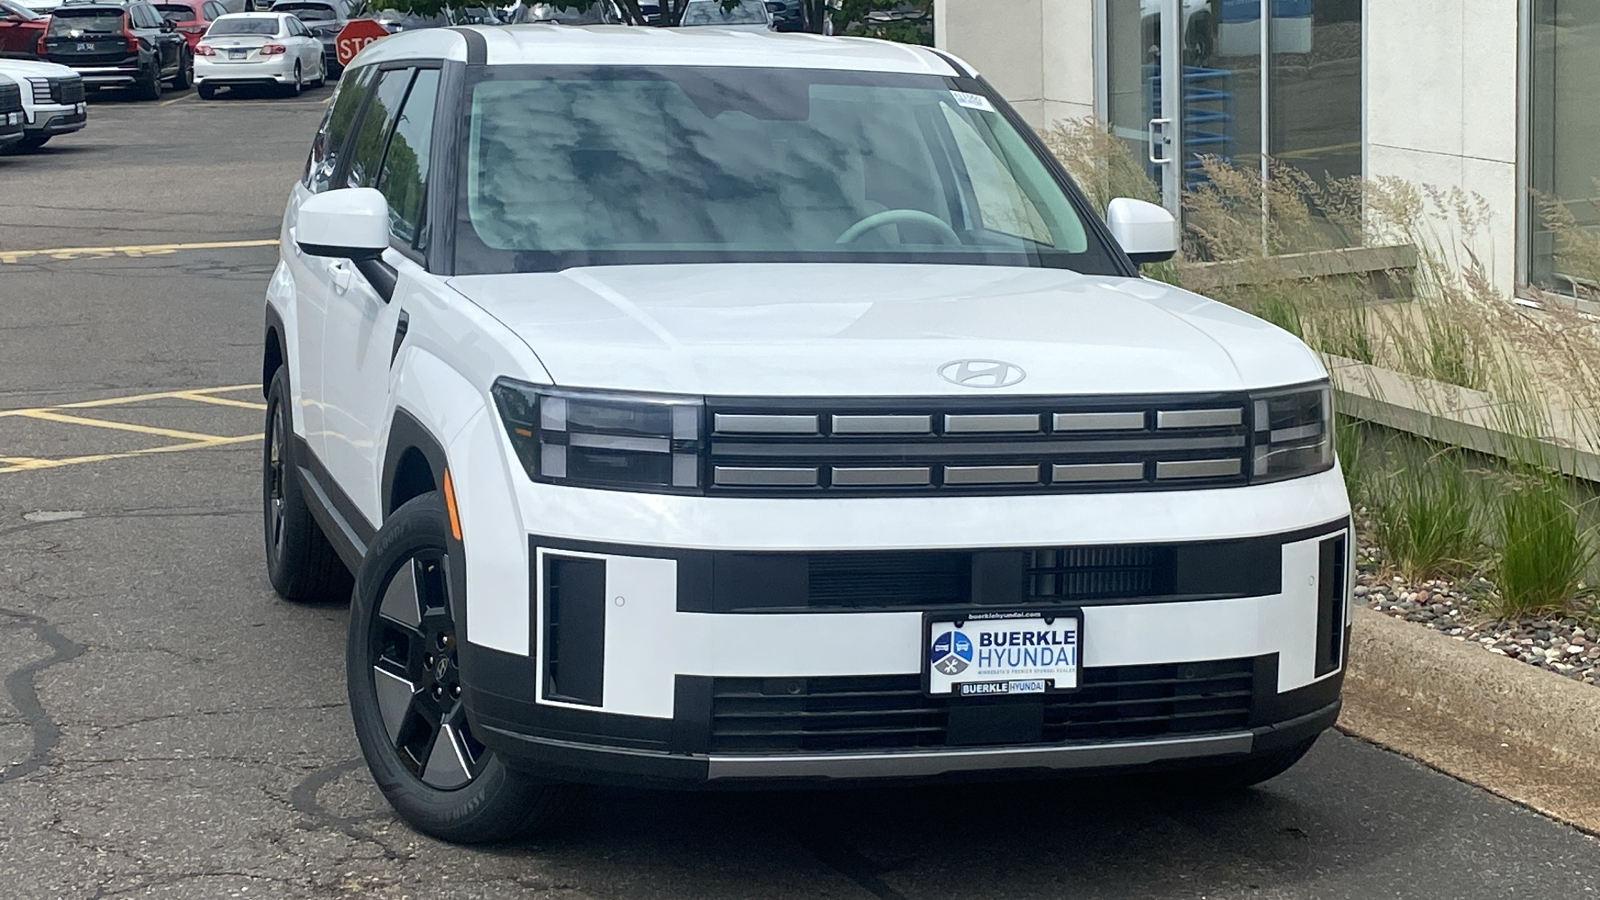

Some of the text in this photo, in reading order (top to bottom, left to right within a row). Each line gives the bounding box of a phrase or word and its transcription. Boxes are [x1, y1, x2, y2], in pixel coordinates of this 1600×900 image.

[340, 36, 384, 59] ST
[968, 611, 1041, 620] buerklehyundai.com
[979, 630, 1076, 647] BUERKLE
[978, 646, 1076, 668] HYUNDAI
[962, 681, 1043, 694] BUERKLE HYUNDAI
